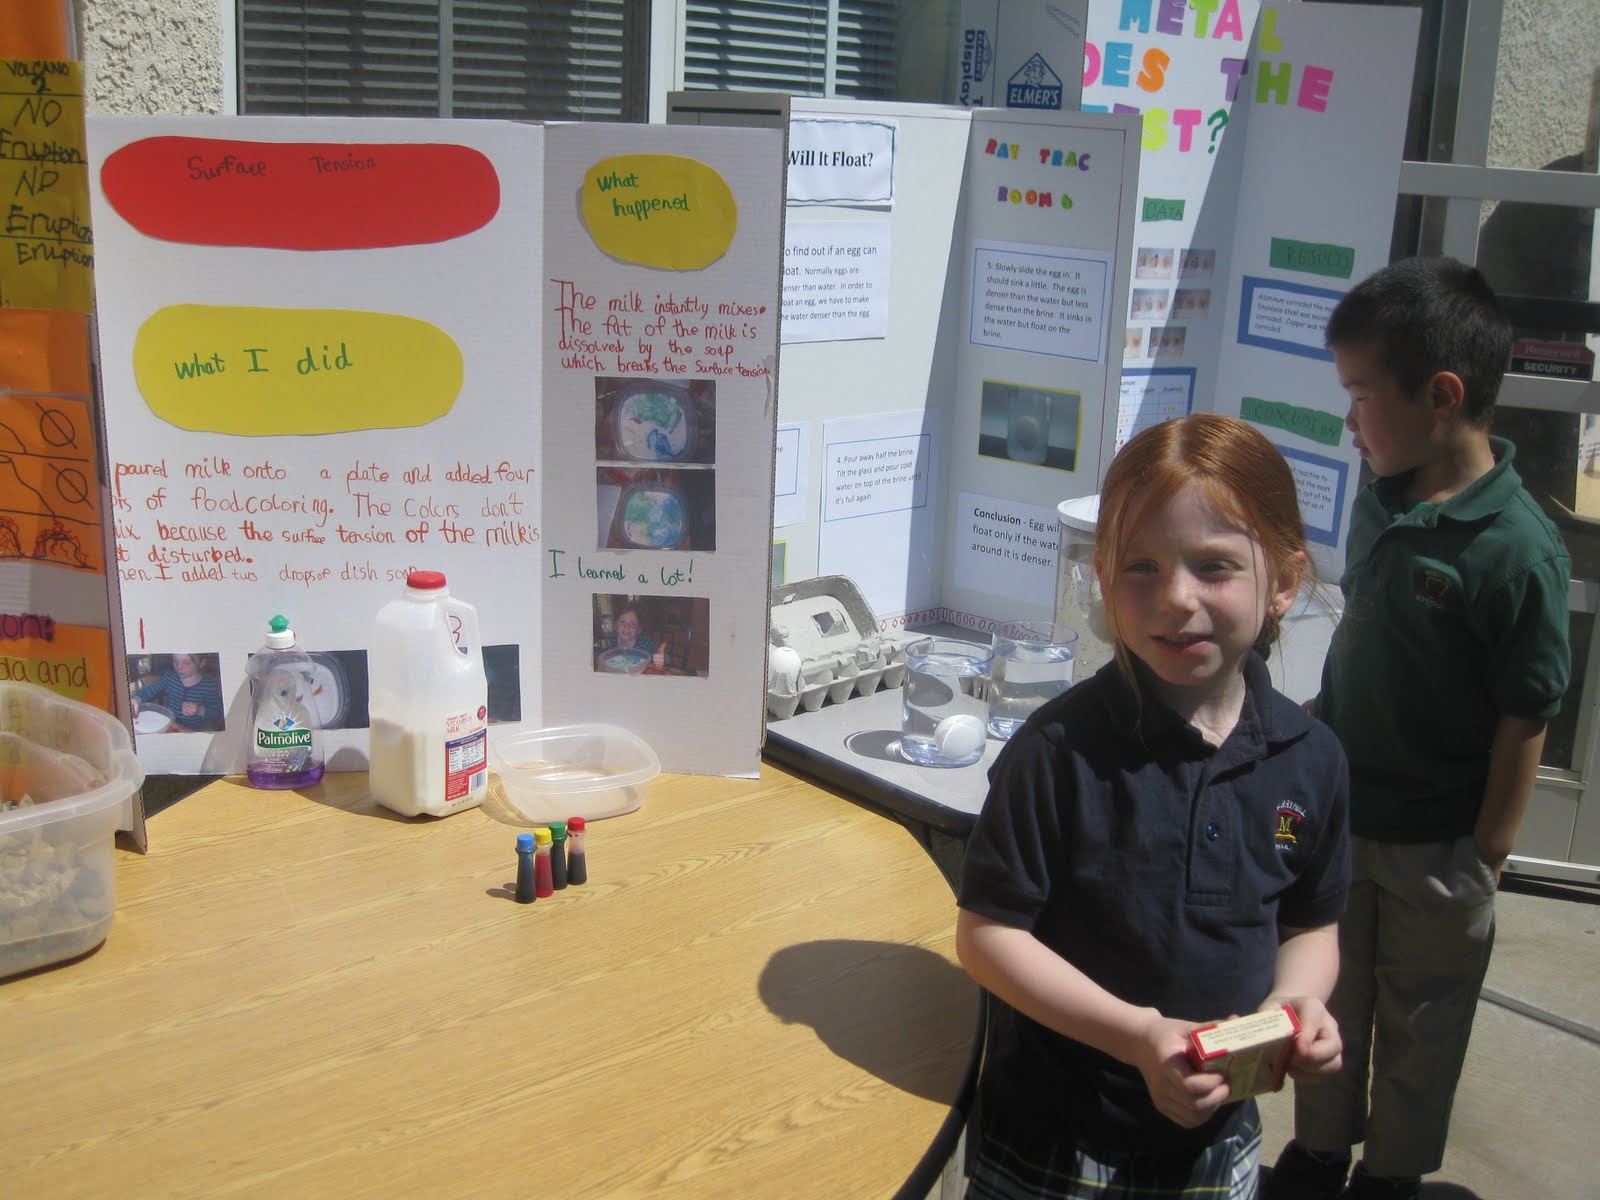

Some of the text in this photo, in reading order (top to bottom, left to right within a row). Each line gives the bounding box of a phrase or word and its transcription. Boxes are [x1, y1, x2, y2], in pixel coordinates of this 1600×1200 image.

[32, 75, 51, 93] 2
[1221, 58, 1334, 112] THE
[1010, 88, 1059, 106] ELMER'S
[14, 97, 61, 127] NO
[0, 128, 81, 162] Eruption
[985, 138, 1090, 171] RAY TRAC
[188, 151, 376, 181] Surface Tension
[788, 151, 873, 167] Will It Float?
[613, 194, 690, 221] happened
[998, 186, 1072, 210] ROOM 6
[1145, 200, 1183, 220] DATA
[6, 204, 93, 244] Eruption
[16, 242, 94, 268] Eruption
[793, 245, 877, 257] find out if an egg can
[805, 266, 848, 275] Normally eggs
[995, 262, 1061, 279] Slowly slide the egg
[802, 283, 816, 291] than
[848, 281, 864, 289] order
[986, 276, 1079, 295] should sink little. The egg
[550, 279, 596, 311] The
[609, 291, 644, 312] milk
[654, 293, 708, 318] instantly
[829, 295, 869, 304] have make
[985, 289, 1008, 299] denser
[1010, 292, 1025, 301] than
[1027, 294, 1038, 302] the
[1061, 298, 1074, 306] but
[1075, 299, 1089, 308] less
[554, 307, 592, 337] The
[645, 315, 666, 337] of
[672, 319, 699, 338] the
[705, 323, 737, 339] milk
[742, 323, 757, 338] is
[810, 311, 831, 319] denser
[832, 310, 846, 318] than
[985, 302, 1083, 322] dense than the brine. sinks
[984, 316, 1071, 334] the water but float the
[243, 348, 269, 373] I
[296, 343, 353, 375] did
[559, 336, 734, 364] dissolved by the soap
[561, 355, 606, 373] which
[617, 354, 658, 375] breaks
[663, 356, 686, 373] the
[1523, 362, 1577, 374] SECURITY
[876, 450, 887, 460] half
[186, 456, 231, 478] milk
[244, 461, 286, 479] onto
[320, 468, 331, 479] a
[346, 460, 389, 494] plate
[403, 464, 432, 484] and
[446, 462, 492, 484] added
[495, 461, 535, 484] four
[858, 461, 912, 476] glass and pour cold
[893, 475, 907, 483] brine
[146, 487, 167, 510] of
[353, 492, 391, 517] The
[482, 492, 523, 517] don't
[157, 519, 227, 541] because
[238, 520, 273, 541] the
[336, 525, 396, 543] tension
[406, 521, 429, 543] of
[439, 519, 475, 543] the
[973, 508, 1044, 532] Conclusion Egg
[973, 524, 1037, 546] float only the
[148, 545, 253, 564] disturbed.
[972, 543, 1053, 567] around is denser.
[155, 563, 173, 581] I
[182, 563, 227, 582] added
[232, 569, 257, 581] two
[341, 560, 378, 581] dish
[548, 549, 693, 586] I learned a lot!
[37, 657, 89, 688] and
[258, 731, 311, 745] Palmolive
